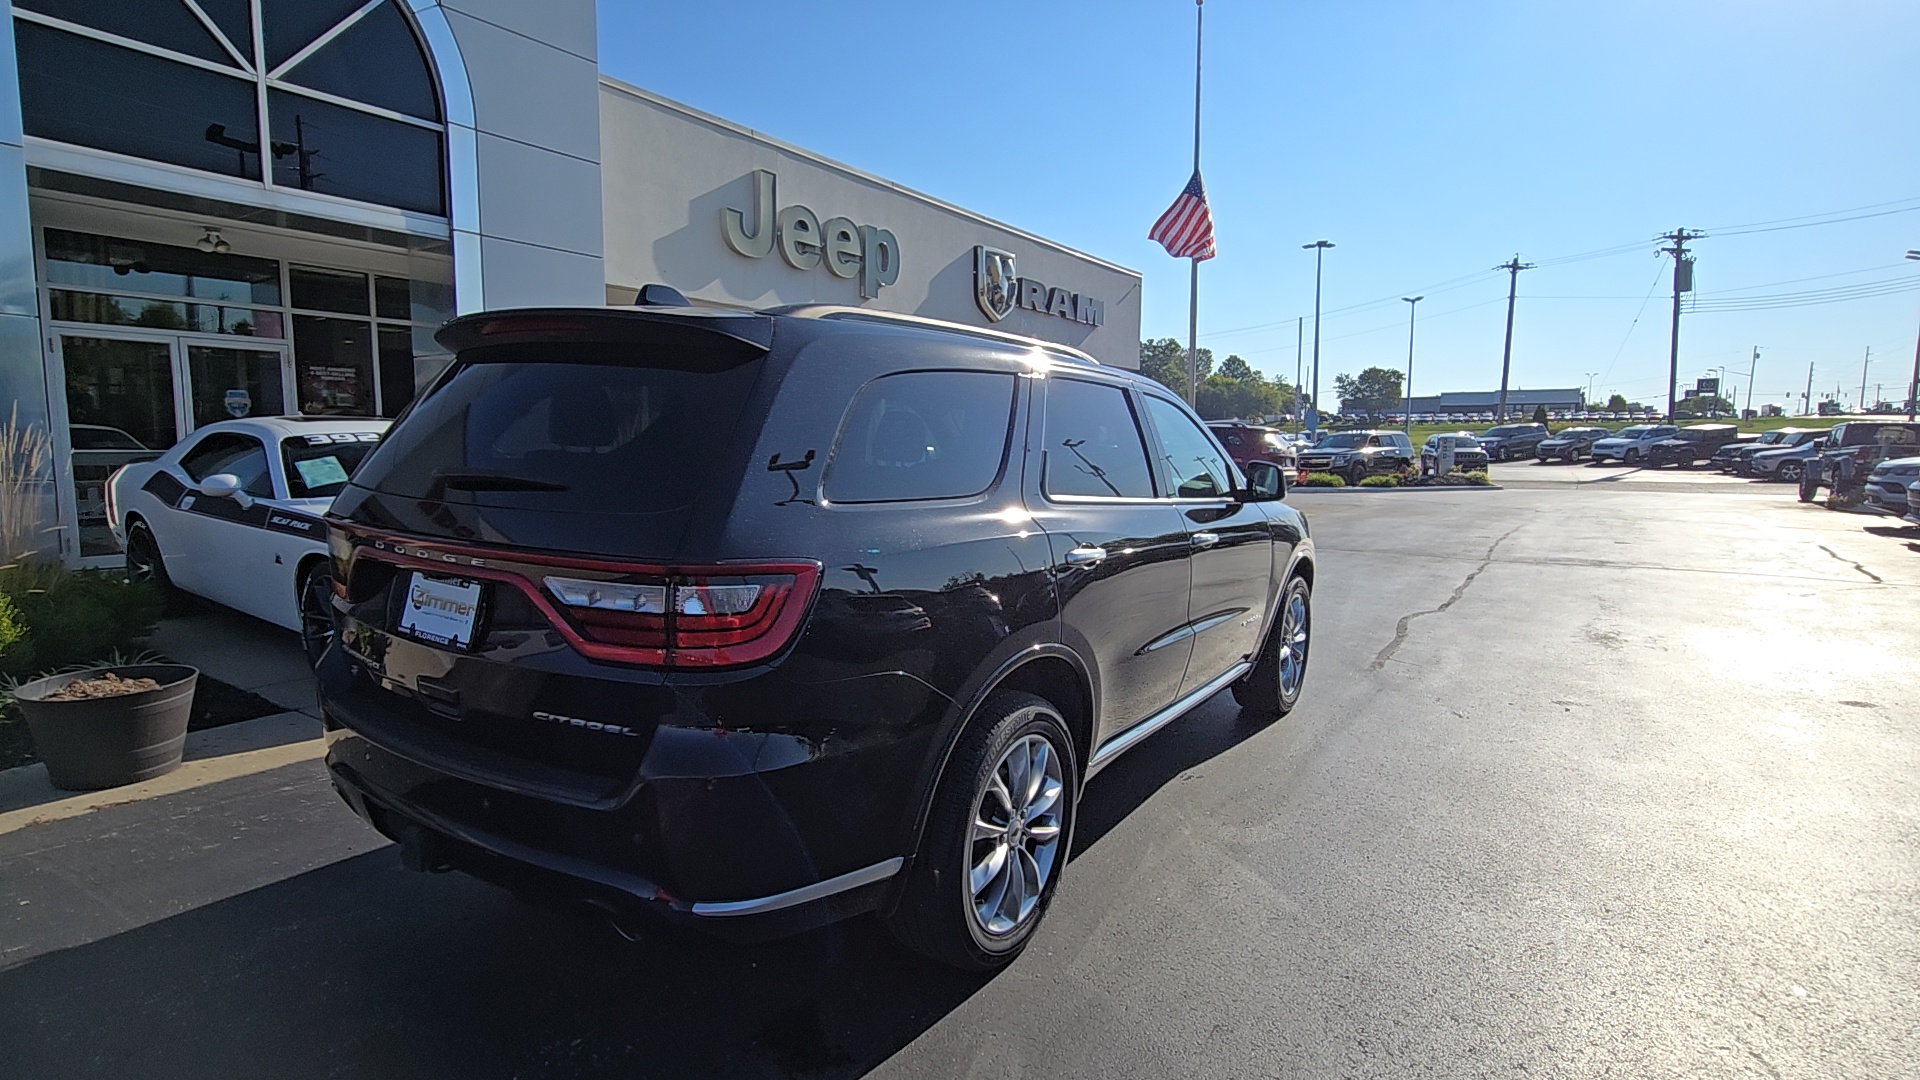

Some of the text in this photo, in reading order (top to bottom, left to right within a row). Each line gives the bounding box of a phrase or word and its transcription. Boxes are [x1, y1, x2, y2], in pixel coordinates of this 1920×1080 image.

[720, 168, 901, 299] Jeep
[1016, 277, 1105, 327] RAM
[303, 432, 380, 446] 392
[270, 516, 313, 531] SCAT PACK
[375, 541, 486, 567] DODGE
[413, 588, 476, 617] Zimmer
[415, 629, 450, 646] FLORENCE
[532, 711, 640, 738] CITADEL
